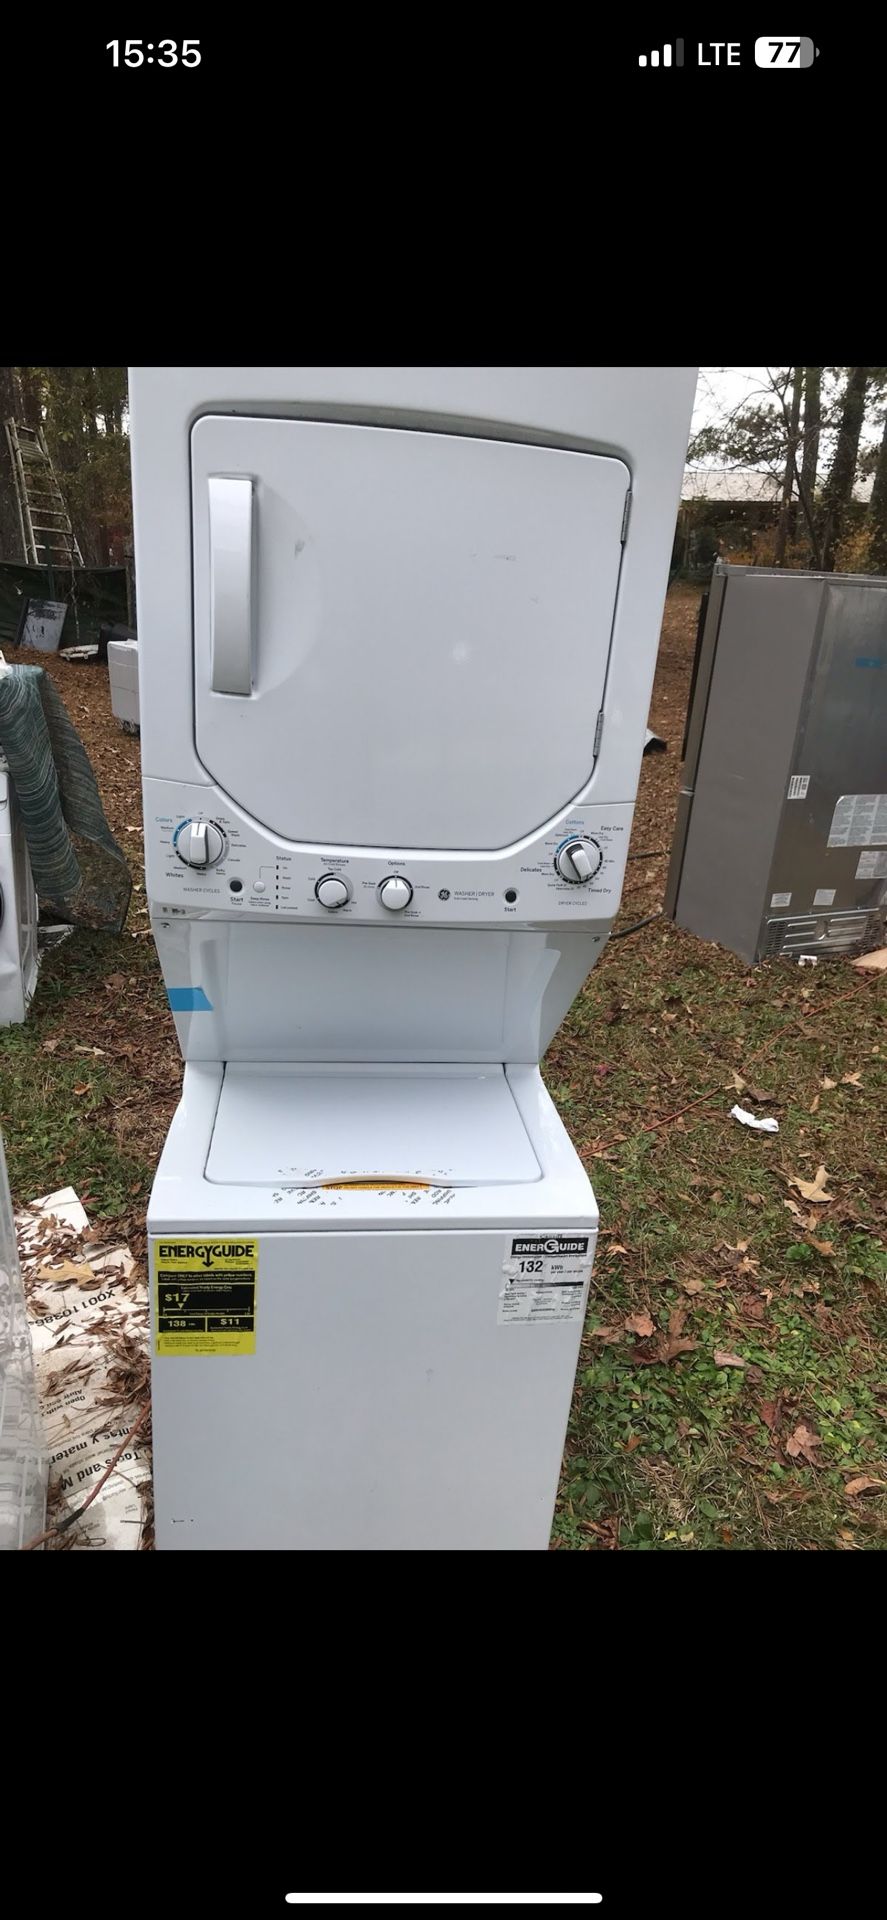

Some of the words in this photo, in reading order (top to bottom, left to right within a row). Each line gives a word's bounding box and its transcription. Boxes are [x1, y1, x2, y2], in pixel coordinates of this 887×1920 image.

[159, 1244, 255, 1258] ENERGYGUIDE
[515, 1239, 585, 1253] ENERGUIDE
[519, 1260, 544, 1273] 132
[164, 1292, 190, 1302] $17
[220, 1318, 240, 1326] $11
[65, 1395, 86, 1406] Open
[76, 1462, 102, 1482] and
